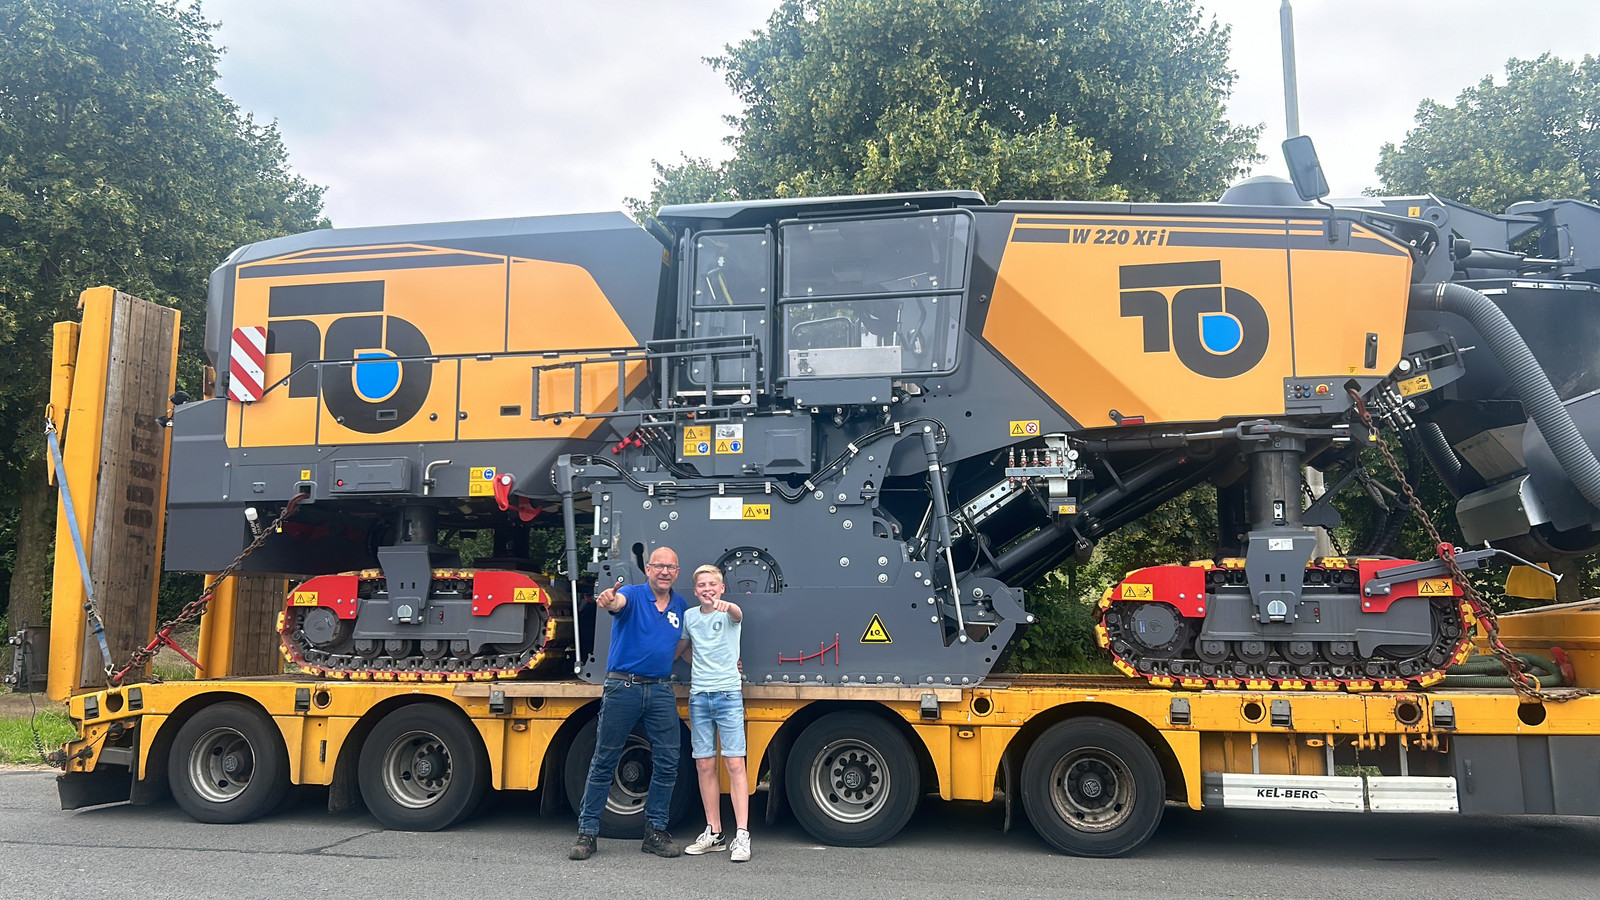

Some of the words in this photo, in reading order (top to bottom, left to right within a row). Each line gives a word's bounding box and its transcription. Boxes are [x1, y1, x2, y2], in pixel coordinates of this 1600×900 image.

[1072, 229, 1092, 244] W
[1093, 229, 1130, 246] 220
[1132, 229, 1166, 246] XFi
[1257, 788, 1319, 799] KEL-BERG
